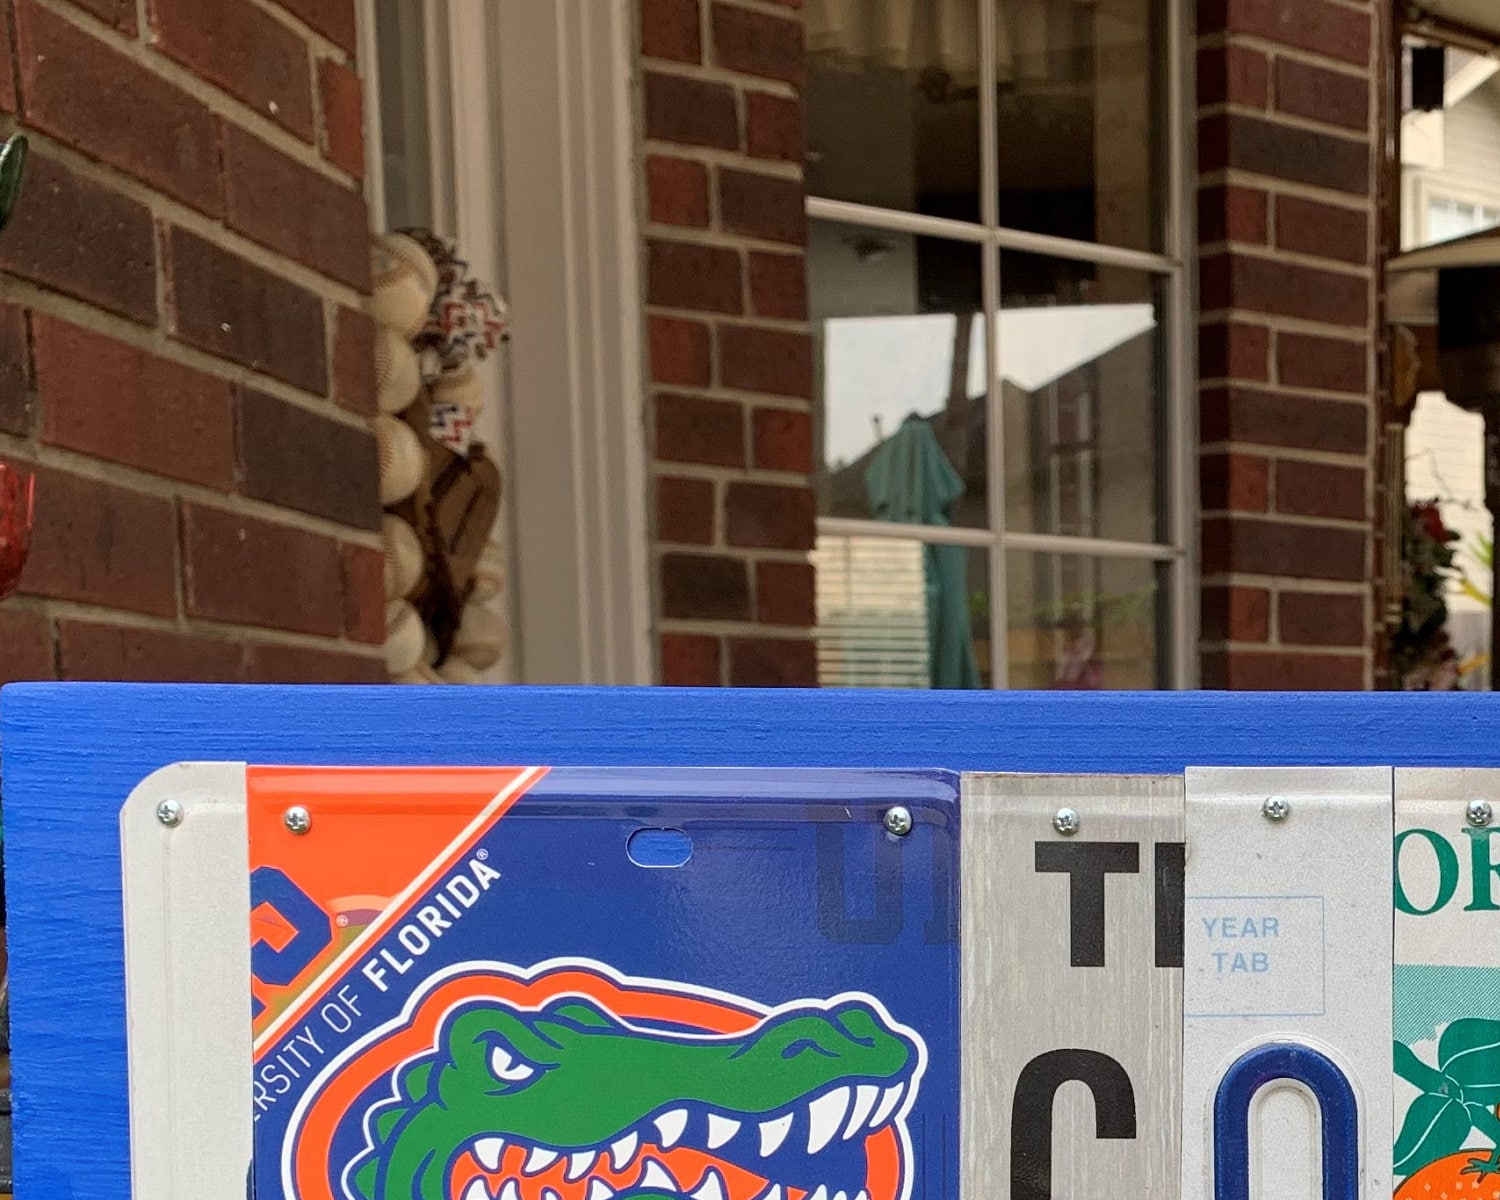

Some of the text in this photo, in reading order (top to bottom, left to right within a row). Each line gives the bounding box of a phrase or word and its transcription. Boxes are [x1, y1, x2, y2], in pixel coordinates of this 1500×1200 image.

[1201, 917, 1280, 938] YEAR
[1211, 951, 1270, 973] TAB
[253, 1026, 325, 1122] RSITY
[321, 984, 362, 1034] OF
[361, 858, 501, 992] FLORIDA
